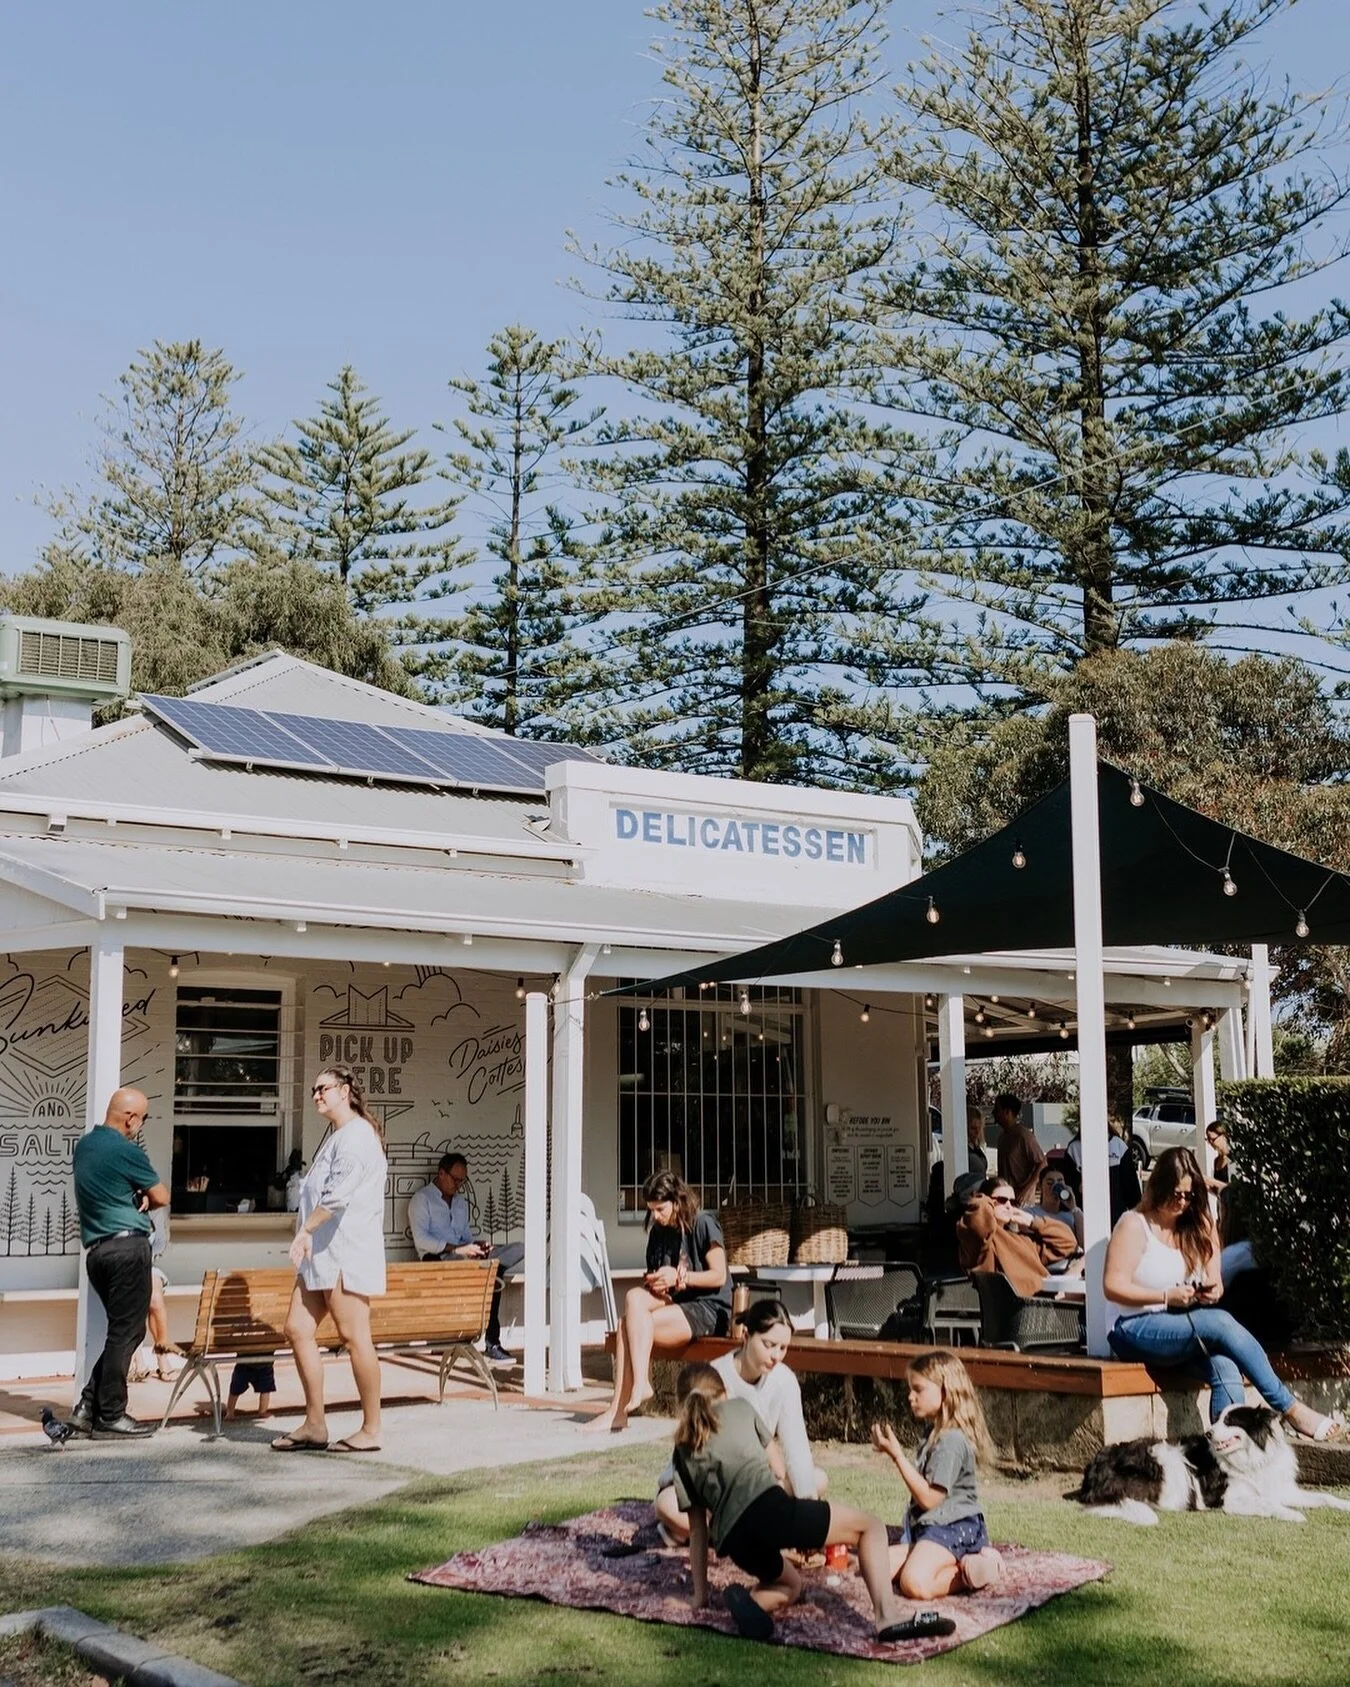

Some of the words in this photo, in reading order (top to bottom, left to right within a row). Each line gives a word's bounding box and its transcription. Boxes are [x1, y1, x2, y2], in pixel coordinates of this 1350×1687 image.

[616, 808, 865, 864] DELICATESSEN
[0, 973, 156, 1054] Sunkied
[320, 1033, 374, 1063] PICK
[383, 1036, 413, 1064] UP
[449, 1031, 527, 1079] Daisies
[351, 1066, 402, 1094] ERE
[468, 1055, 527, 1104] Cottes
[38, 1102, 64, 1117] AND
[0, 1133, 80, 1157] SALT
